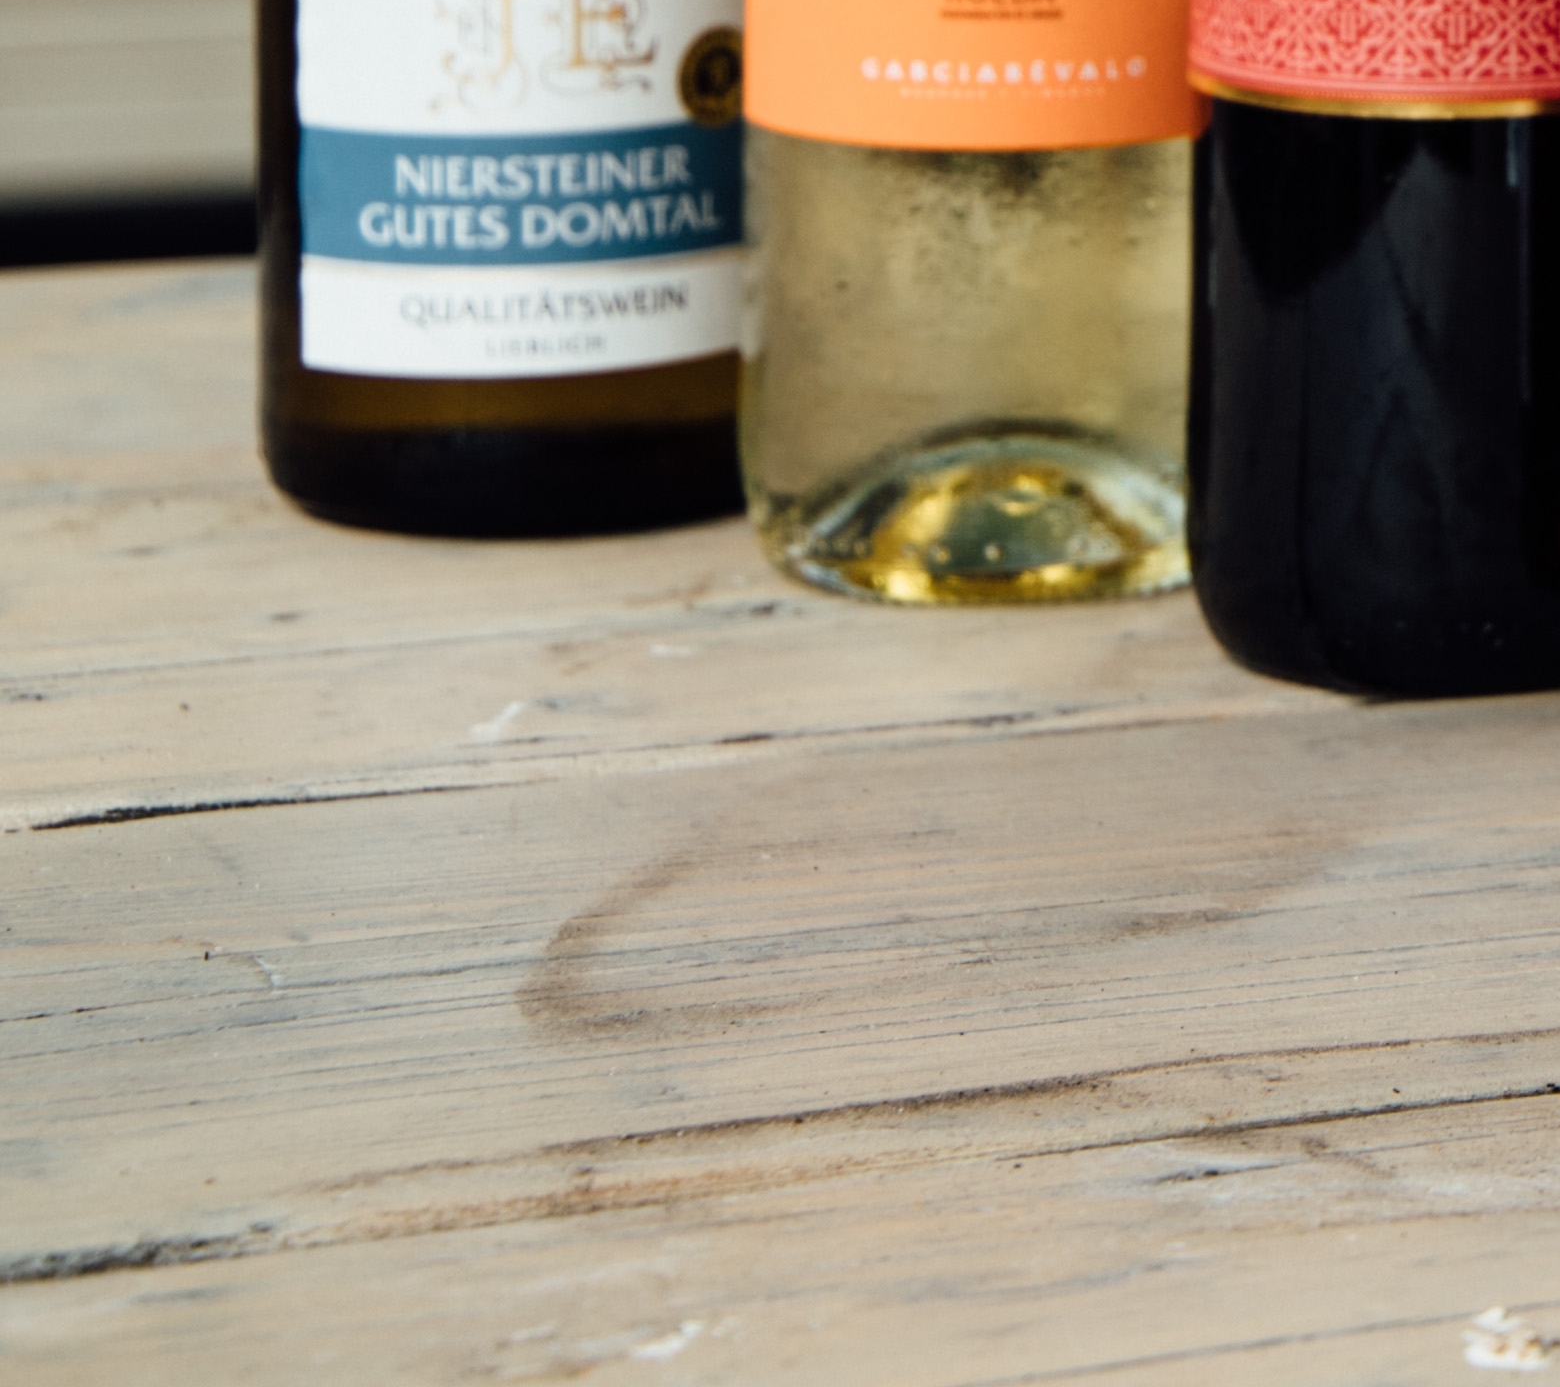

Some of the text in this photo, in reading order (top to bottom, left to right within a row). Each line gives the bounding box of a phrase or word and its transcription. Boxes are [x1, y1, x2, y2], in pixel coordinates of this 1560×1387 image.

[394, 145, 690, 200] NIERSTEINER
[359, 191, 720, 250] GUTES DOMTAL
[399, 280, 691, 328] QUALITÄTSWEIN
